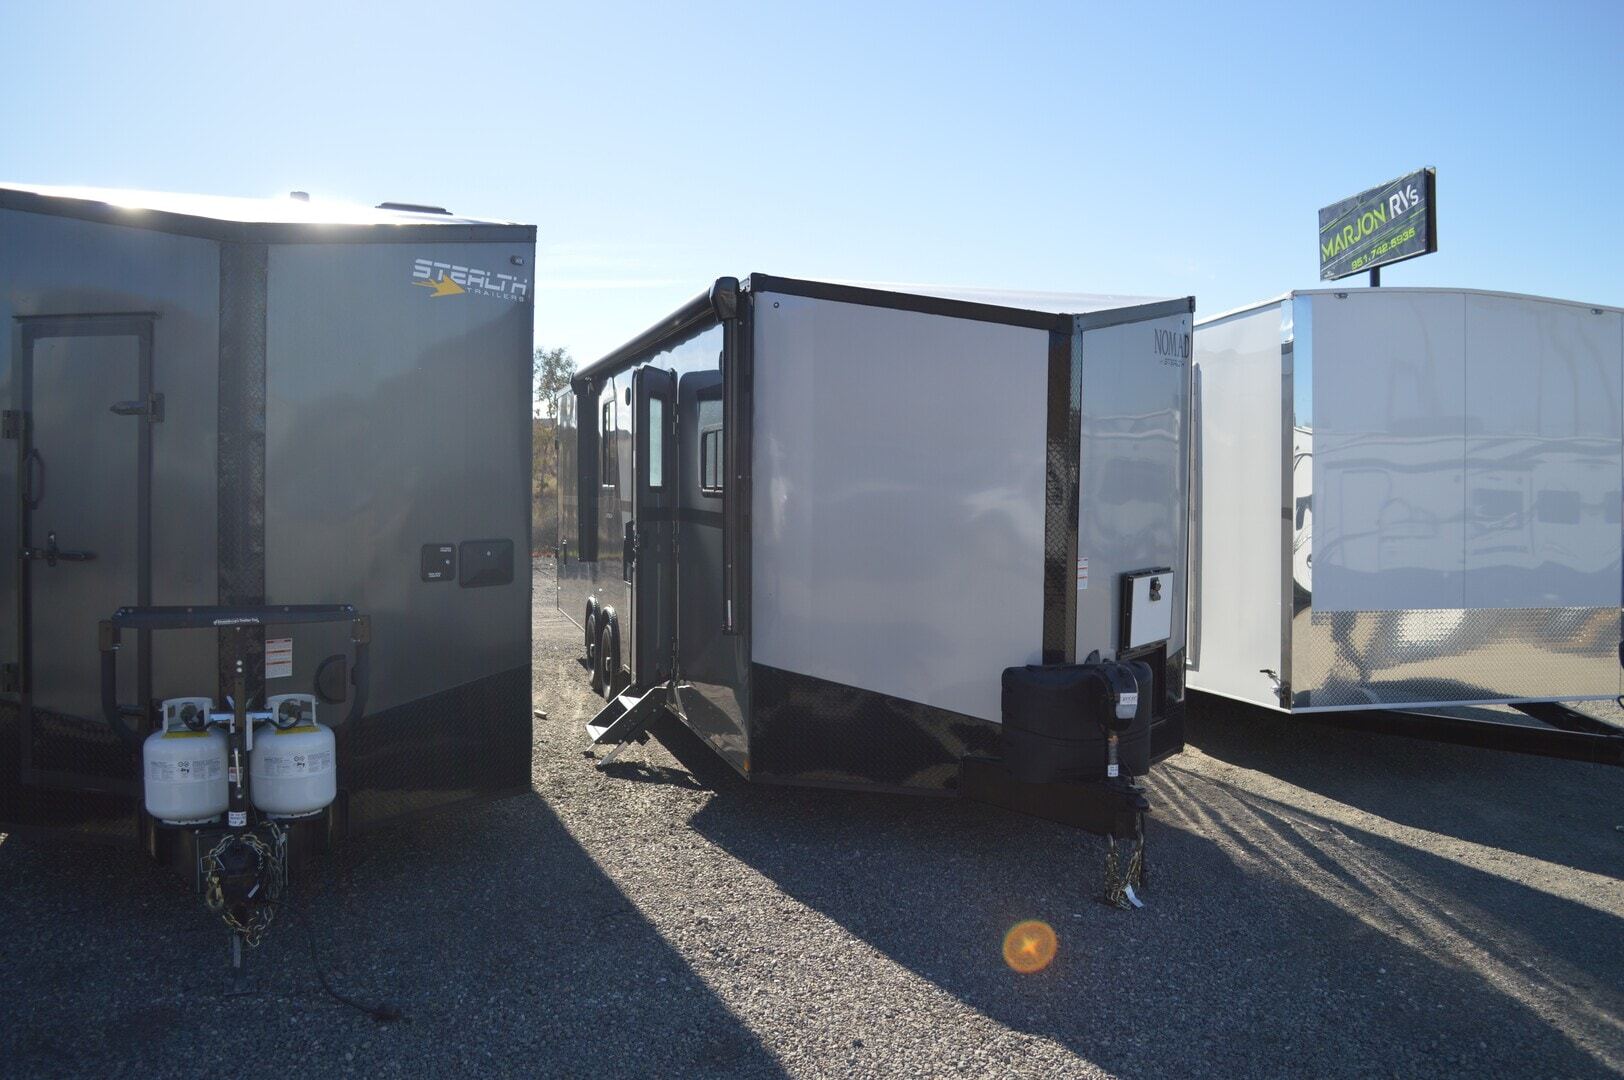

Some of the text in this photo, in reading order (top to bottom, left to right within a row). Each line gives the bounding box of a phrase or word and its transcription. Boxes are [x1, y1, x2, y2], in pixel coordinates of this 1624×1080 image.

[1321, 184, 1419, 262] MARJON RVs
[412, 258, 528, 296] STEALTH
[466, 287, 525, 303] TRAILERS
[1154, 328, 1190, 359] NOMAD
